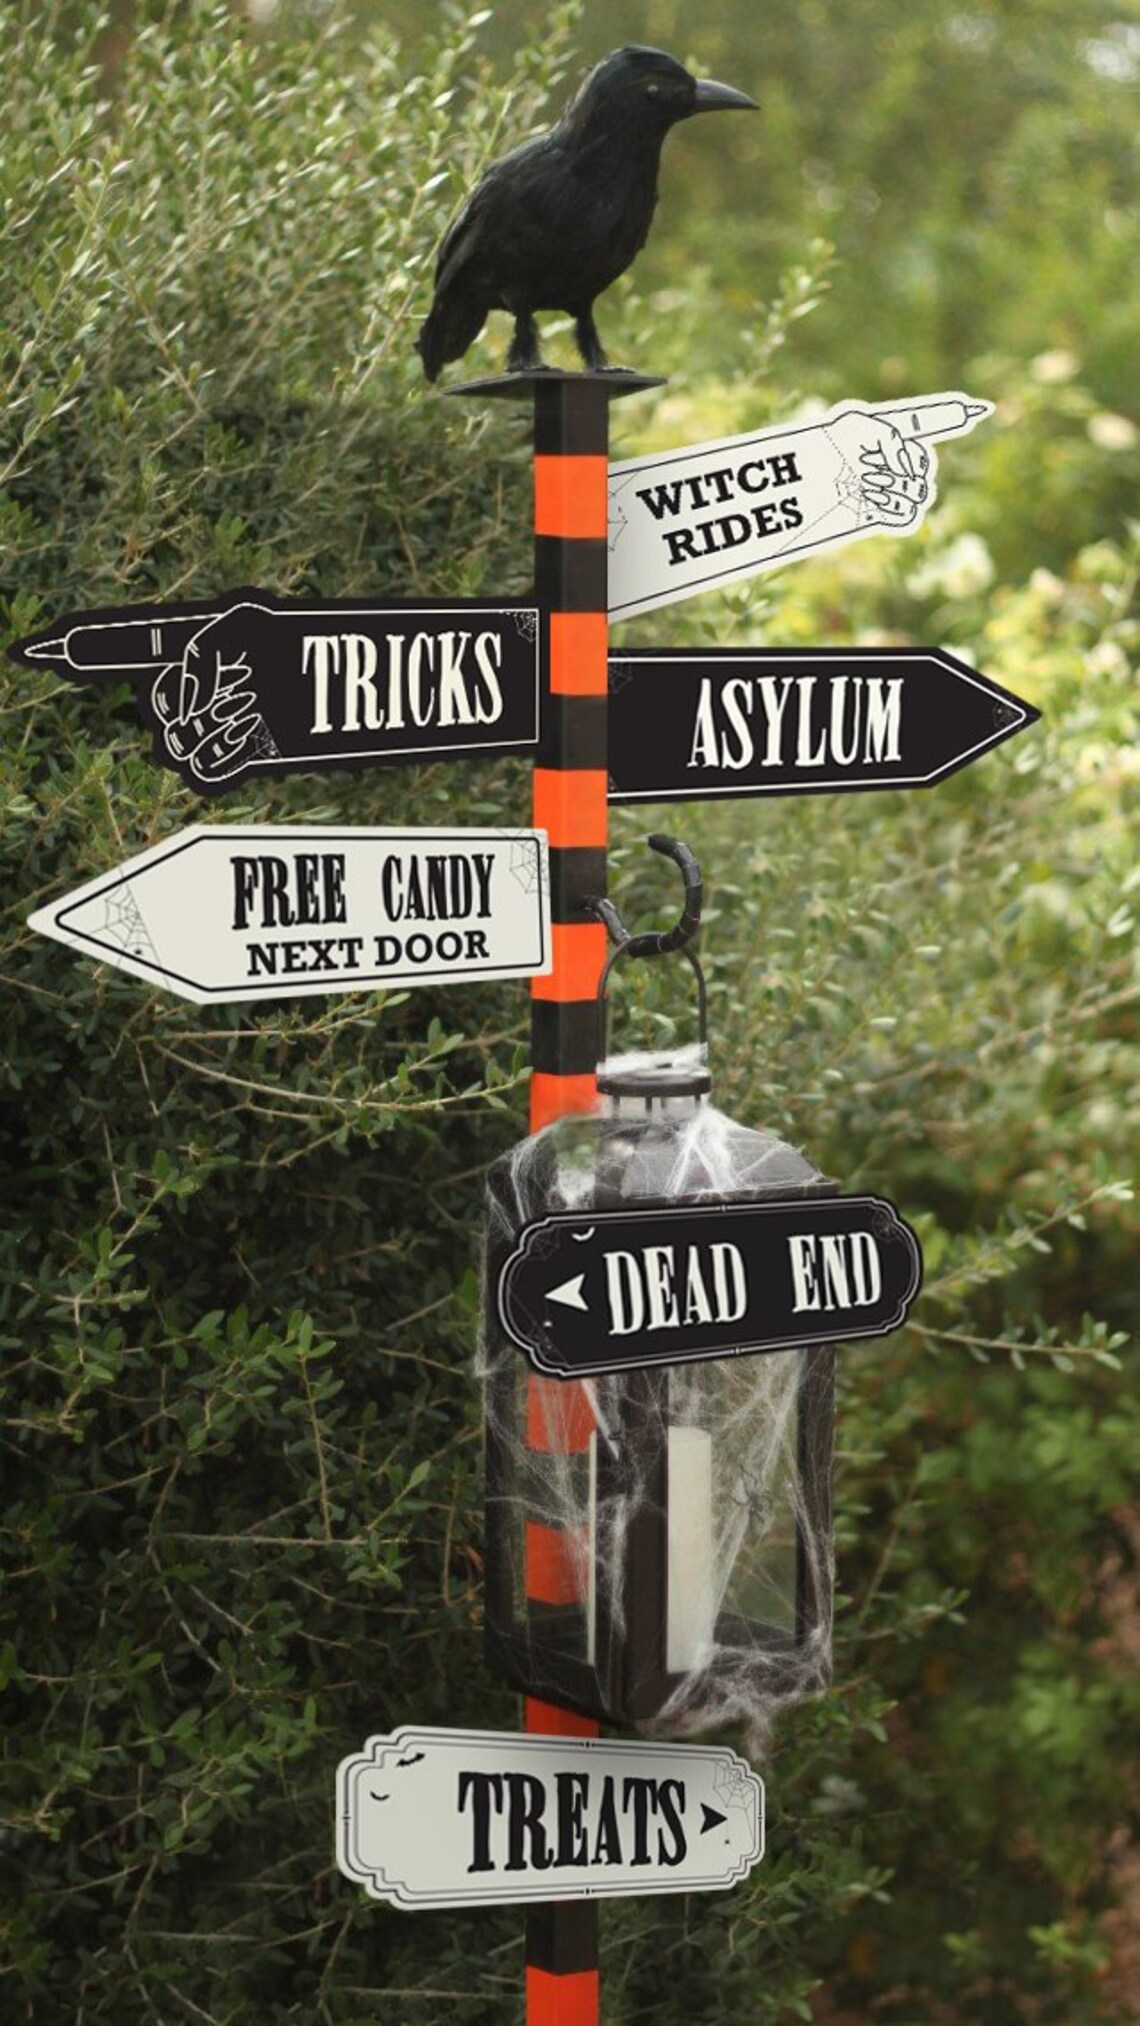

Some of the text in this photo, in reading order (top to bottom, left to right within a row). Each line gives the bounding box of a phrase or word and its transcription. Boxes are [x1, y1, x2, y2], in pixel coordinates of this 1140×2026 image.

[636, 452, 802, 520] WITCH
[662, 496, 804, 566] RIDES
[302, 631, 503, 734] TRICKS
[687, 676, 904, 769] ASYLUM
[230, 853, 496, 931] FREE CANDY
[246, 930, 490, 976] NEXT DOOR
[603, 1231, 883, 1335] DEAD END
[457, 1771, 687, 1874] TREATS
